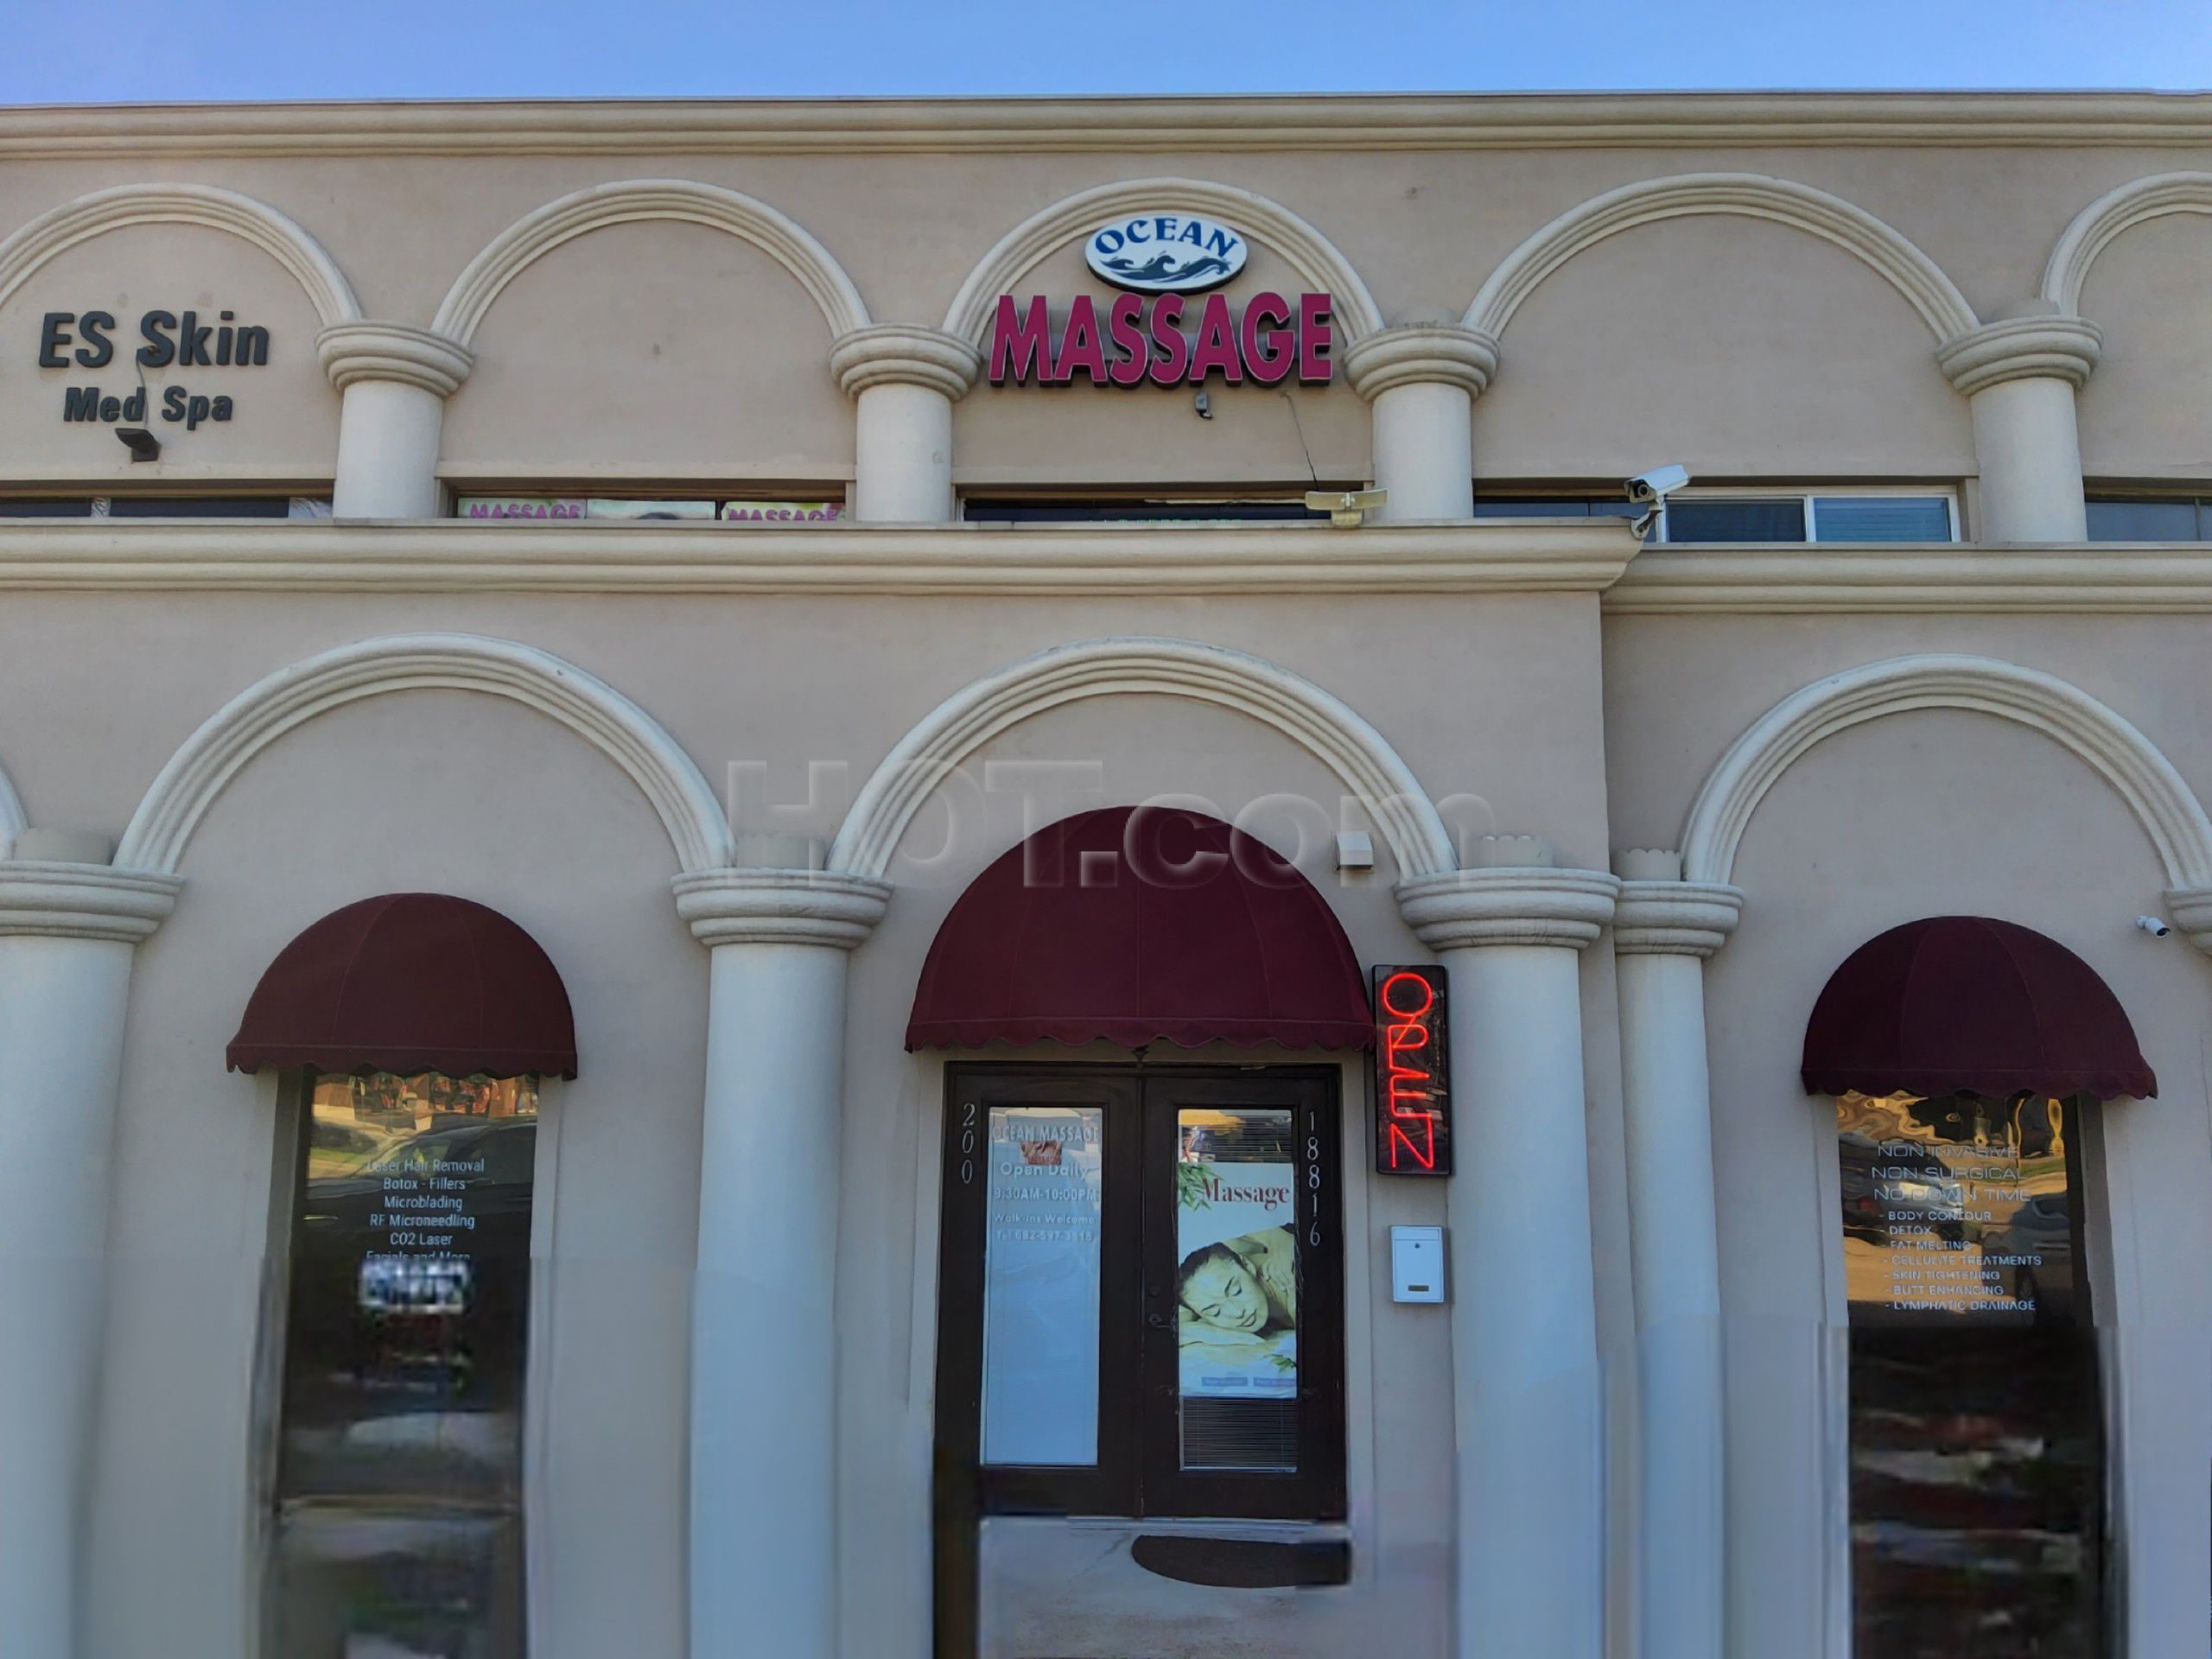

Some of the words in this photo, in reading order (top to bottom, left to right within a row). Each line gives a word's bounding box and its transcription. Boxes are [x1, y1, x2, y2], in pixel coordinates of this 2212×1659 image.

[1095, 217, 1238, 259] OCEAN
[39, 310, 115, 368] ES
[135, 309, 270, 368] Skin
[988, 291, 1332, 389] MASSAGE
[63, 386, 146, 423] Med
[162, 385, 233, 431] Spa
[469, 503, 581, 519] MASSAGE
[1382, 971, 1434, 1169] OPEN
[993, 1125, 1035, 1141] OCEAN
[1039, 1125, 1099, 1141] MASSAGE
[961, 1103, 976, 1184] 200
[1878, 1145, 1924, 1157] NON
[1931, 1145, 2020, 1159] INVASIVE
[404, 1158, 429, 1173] Hair
[433, 1158, 485, 1173] Removal
[1000, 1161, 1043, 1179] Open
[1048, 1161, 1089, 1181] Daily
[1872, 1166, 1918, 1179] NON
[1925, 1166, 2027, 1180] SURGICAL
[383, 1176, 418, 1190] Botox
[429, 1176, 467, 1191] Fillers
[1306, 1111, 1321, 1247] 18816
[1202, 1178, 1290, 1211] Massage
[1874, 1188, 1905, 1201] NO
[1912, 1188, 1977, 1202] DOWN
[1984, 1188, 2032, 1203] TIME
[384, 1195, 463, 1211] Microblading
[370, 1213, 385, 1226] RF
[389, 1213, 475, 1230] Microneedling
[1888, 1211, 1923, 1221] BODY
[1928, 1211, 1992, 1222] CONTOUR
[1889, 1225, 1933, 1236] DETOX
[390, 1232, 416, 1246] CO2
[419, 1232, 454, 1246] Laser
[1890, 1240, 1915, 1250] FAT
[1916, 1240, 1974, 1251] MELTING
[1891, 1255, 1956, 1266] CELLULITE
[1961, 1255, 2043, 1266] TREATMENTS
[1892, 1270, 1921, 1281] SKIN
[1924, 1270, 2001, 1281] TIGHTENING
[1893, 1285, 1926, 1295] BUTT
[1929, 1285, 2005, 1295] ENHANCING
[1893, 1300, 1967, 1311] LYMPHATIC
[1970, 1300, 2037, 1311] DRAINAGE
